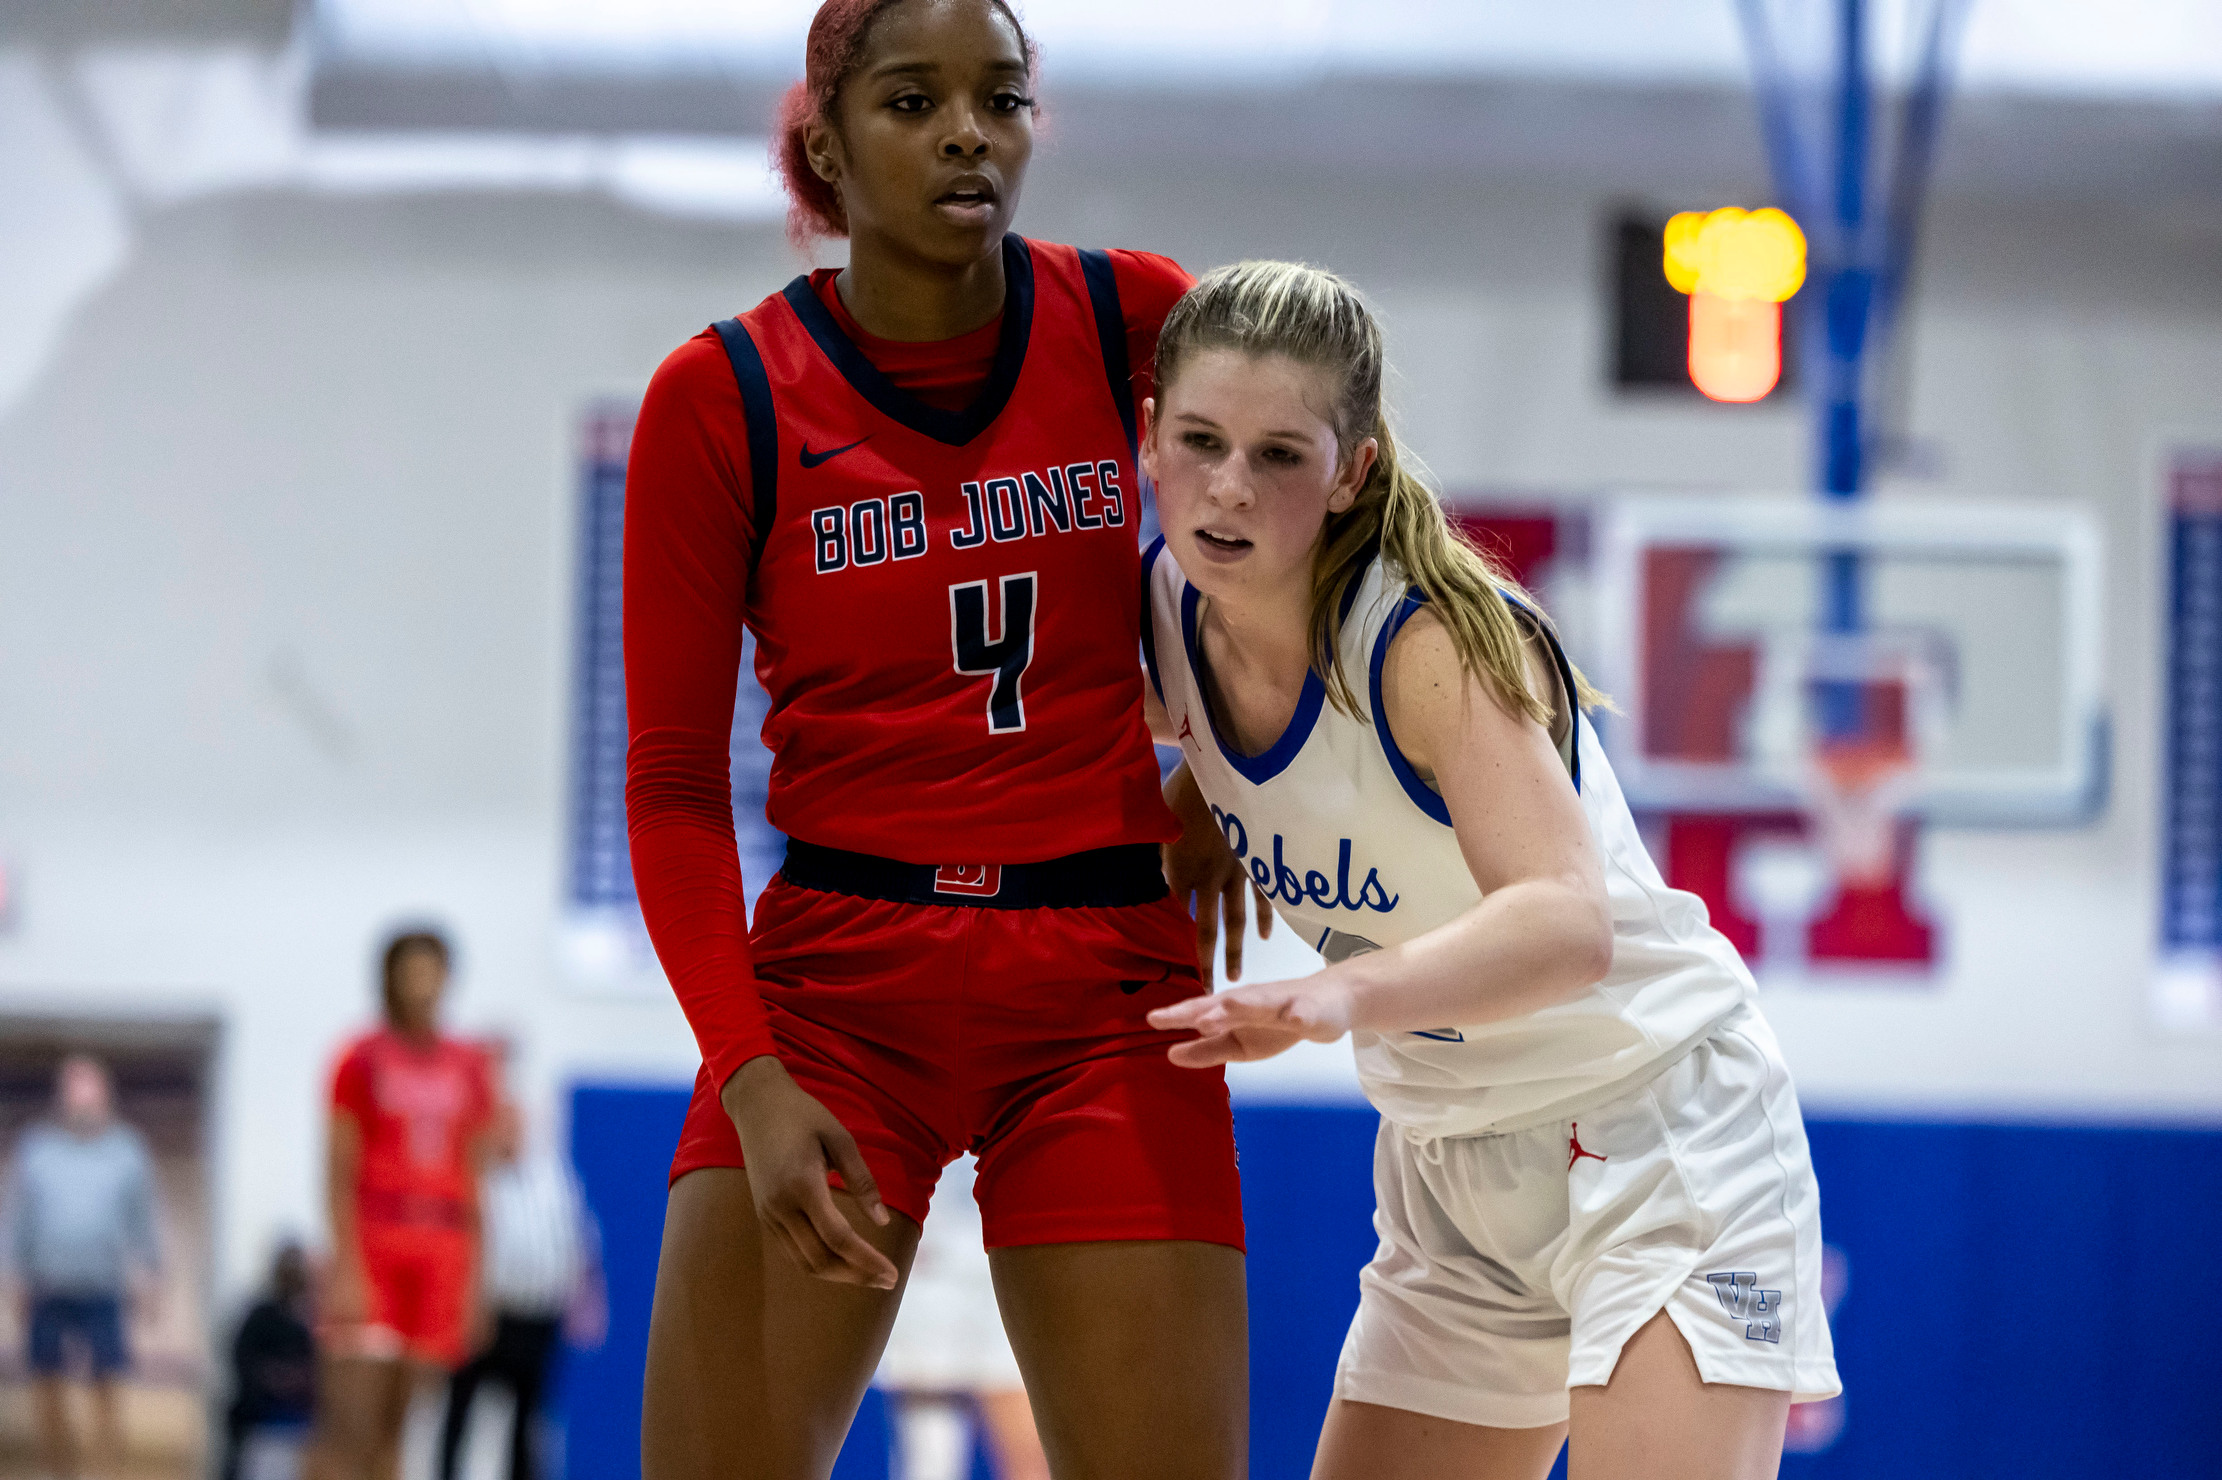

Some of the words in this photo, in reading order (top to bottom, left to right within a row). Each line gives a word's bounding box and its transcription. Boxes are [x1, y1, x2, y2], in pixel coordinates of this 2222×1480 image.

[811, 490, 927, 574] BOB
[950, 460, 1125, 550] JONES
[948, 571, 1037, 734] 4
